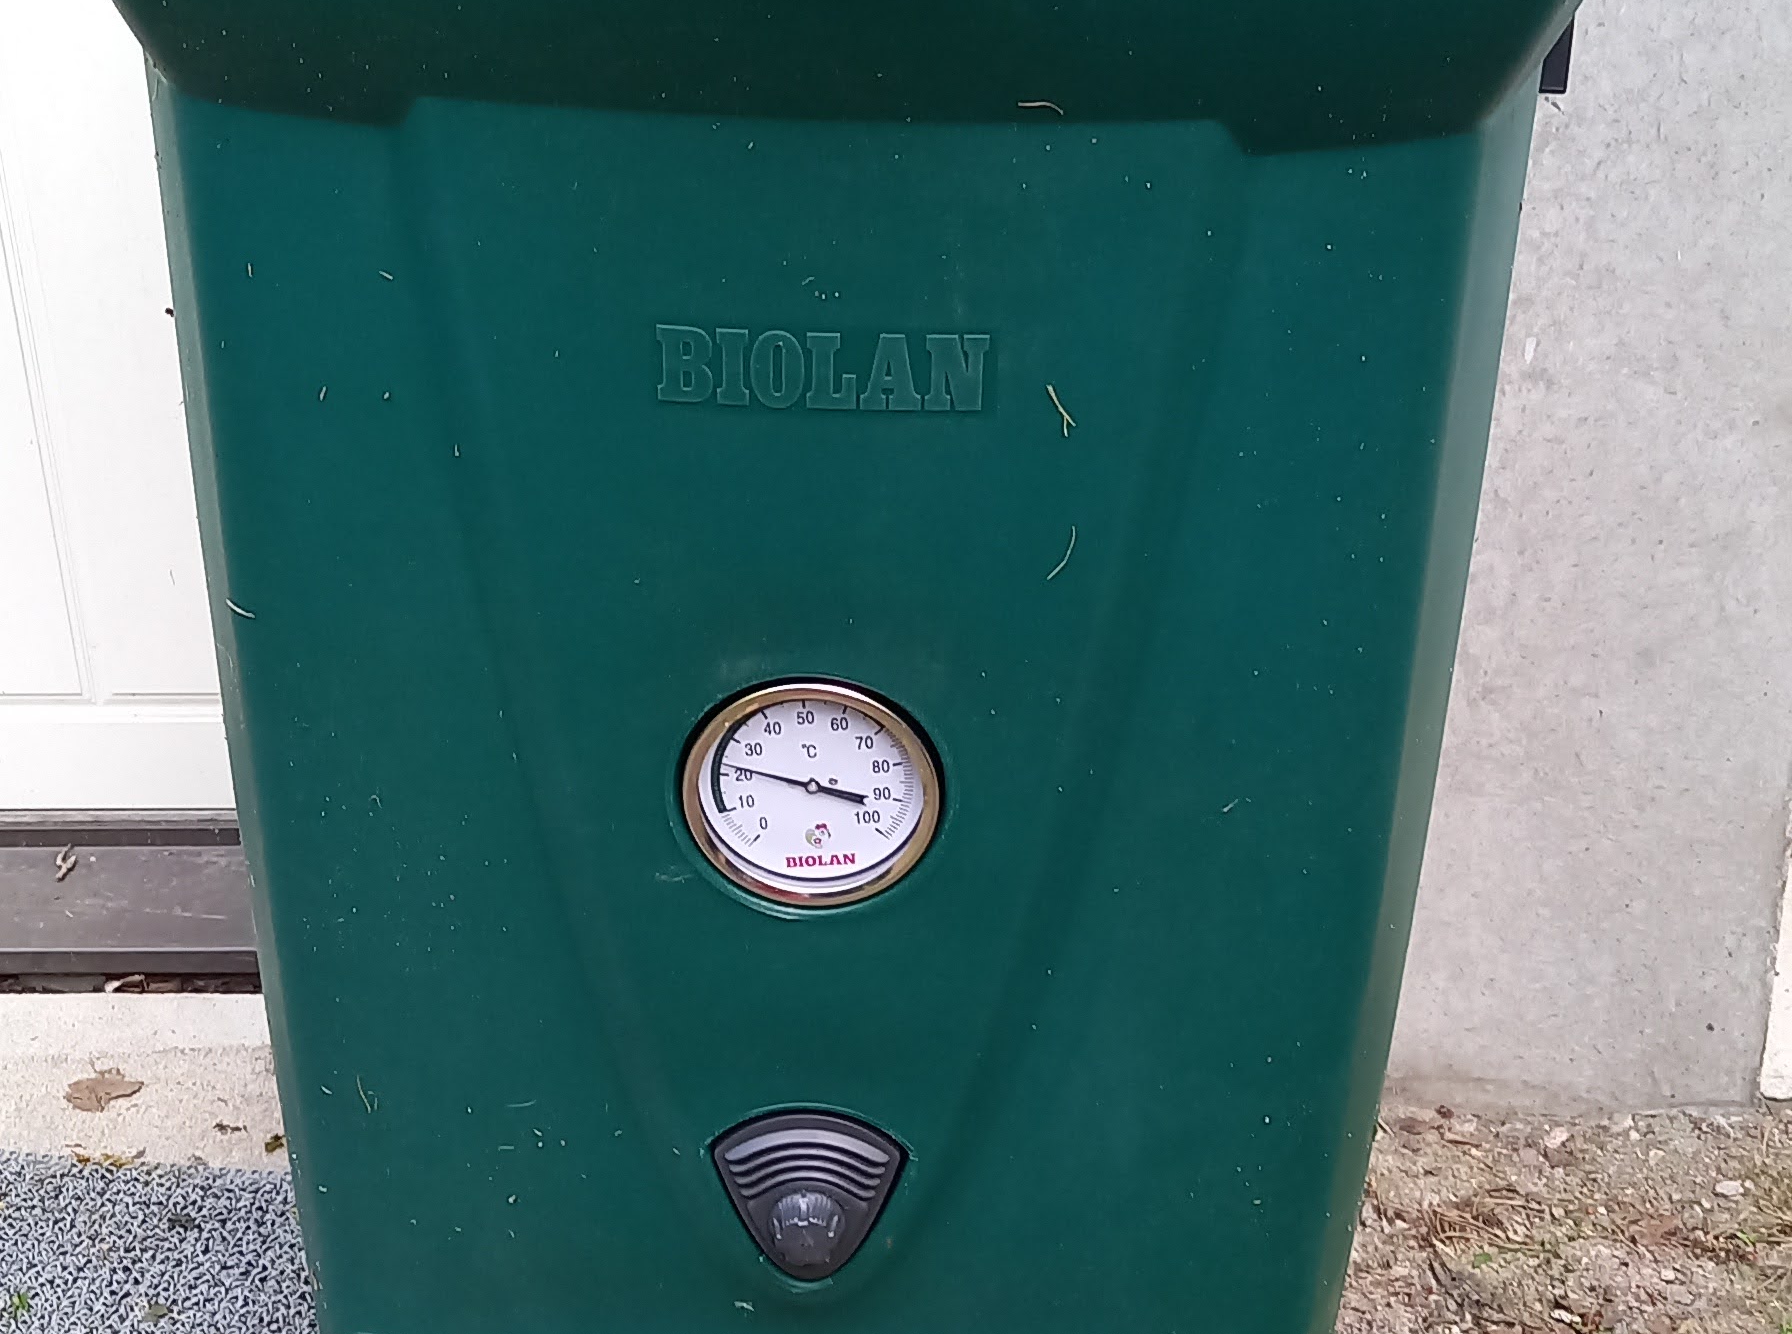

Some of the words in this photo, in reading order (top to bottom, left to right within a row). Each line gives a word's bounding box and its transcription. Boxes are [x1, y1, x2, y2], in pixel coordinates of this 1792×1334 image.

[655, 323, 991, 412] BIOLAN
[796, 710, 815, 725] 50
[830, 717, 849, 732] 60
[763, 721, 782, 736] 40
[744, 742, 763, 757] 30
[855, 736, 874, 750] 70
[872, 760, 891, 774] 80
[734, 768, 753, 782] 20
[873, 786, 892, 801] 90
[738, 795, 755, 809] 10
[759, 817, 767, 830] 0
[854, 810, 881, 825] 100
[785, 853, 857, 868] BIOLAN
